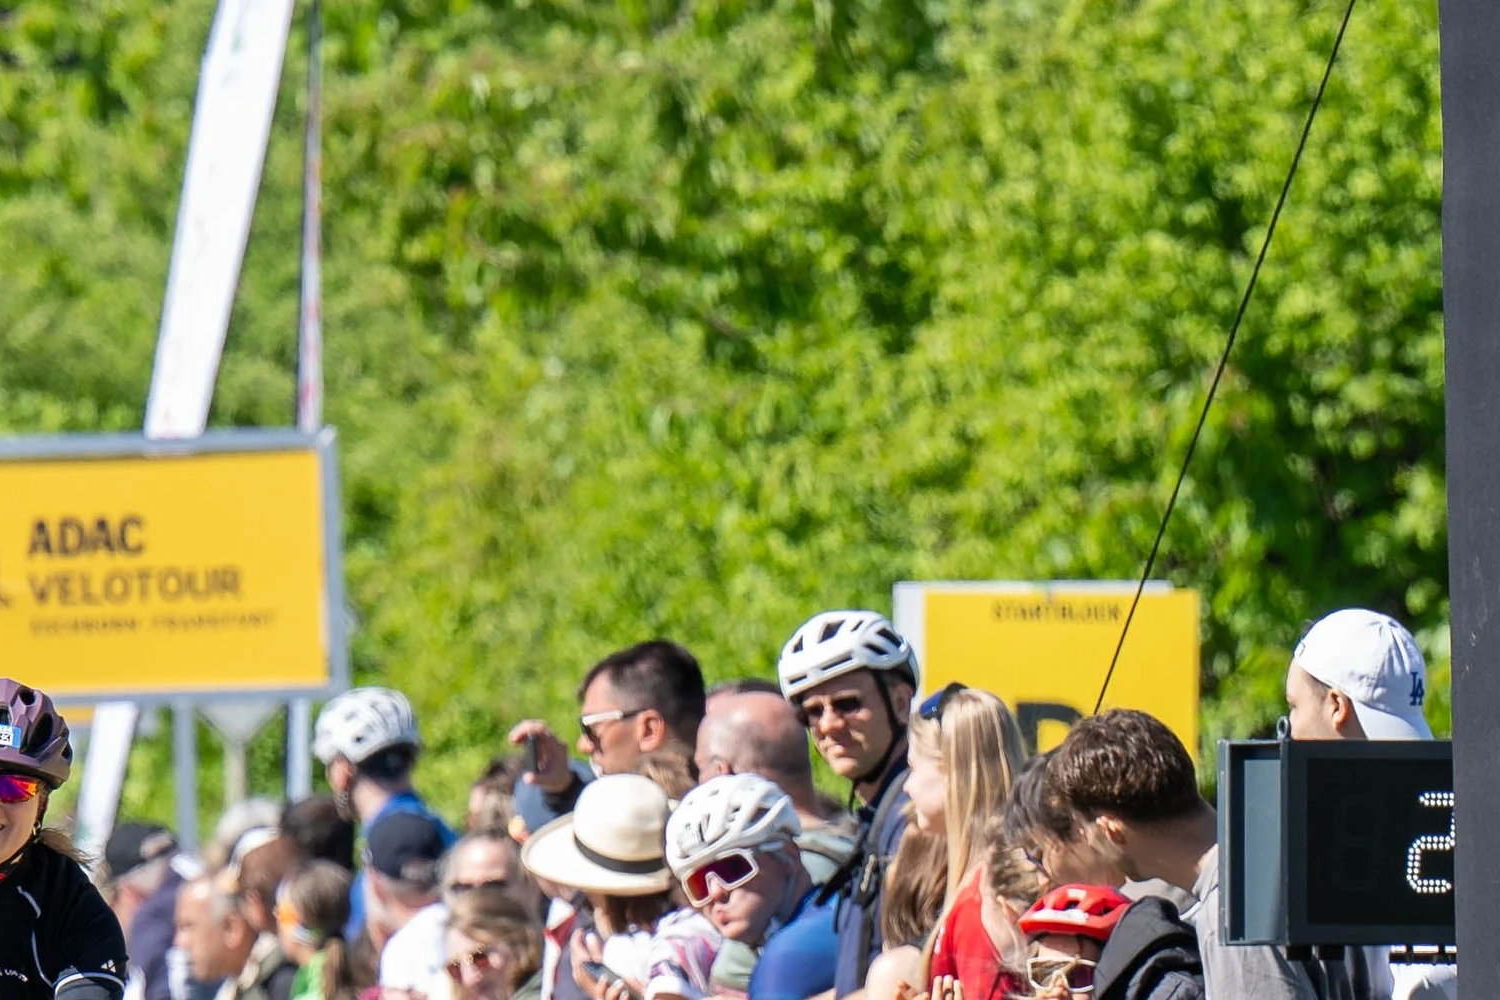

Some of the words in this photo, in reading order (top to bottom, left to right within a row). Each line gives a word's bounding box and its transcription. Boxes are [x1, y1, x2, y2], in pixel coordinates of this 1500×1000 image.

[28, 515, 146, 556] ADAC
[28, 566, 243, 603] VELOTOUR
[1410, 671, 1424, 706] LA
[1407, 792, 1455, 892] 2
